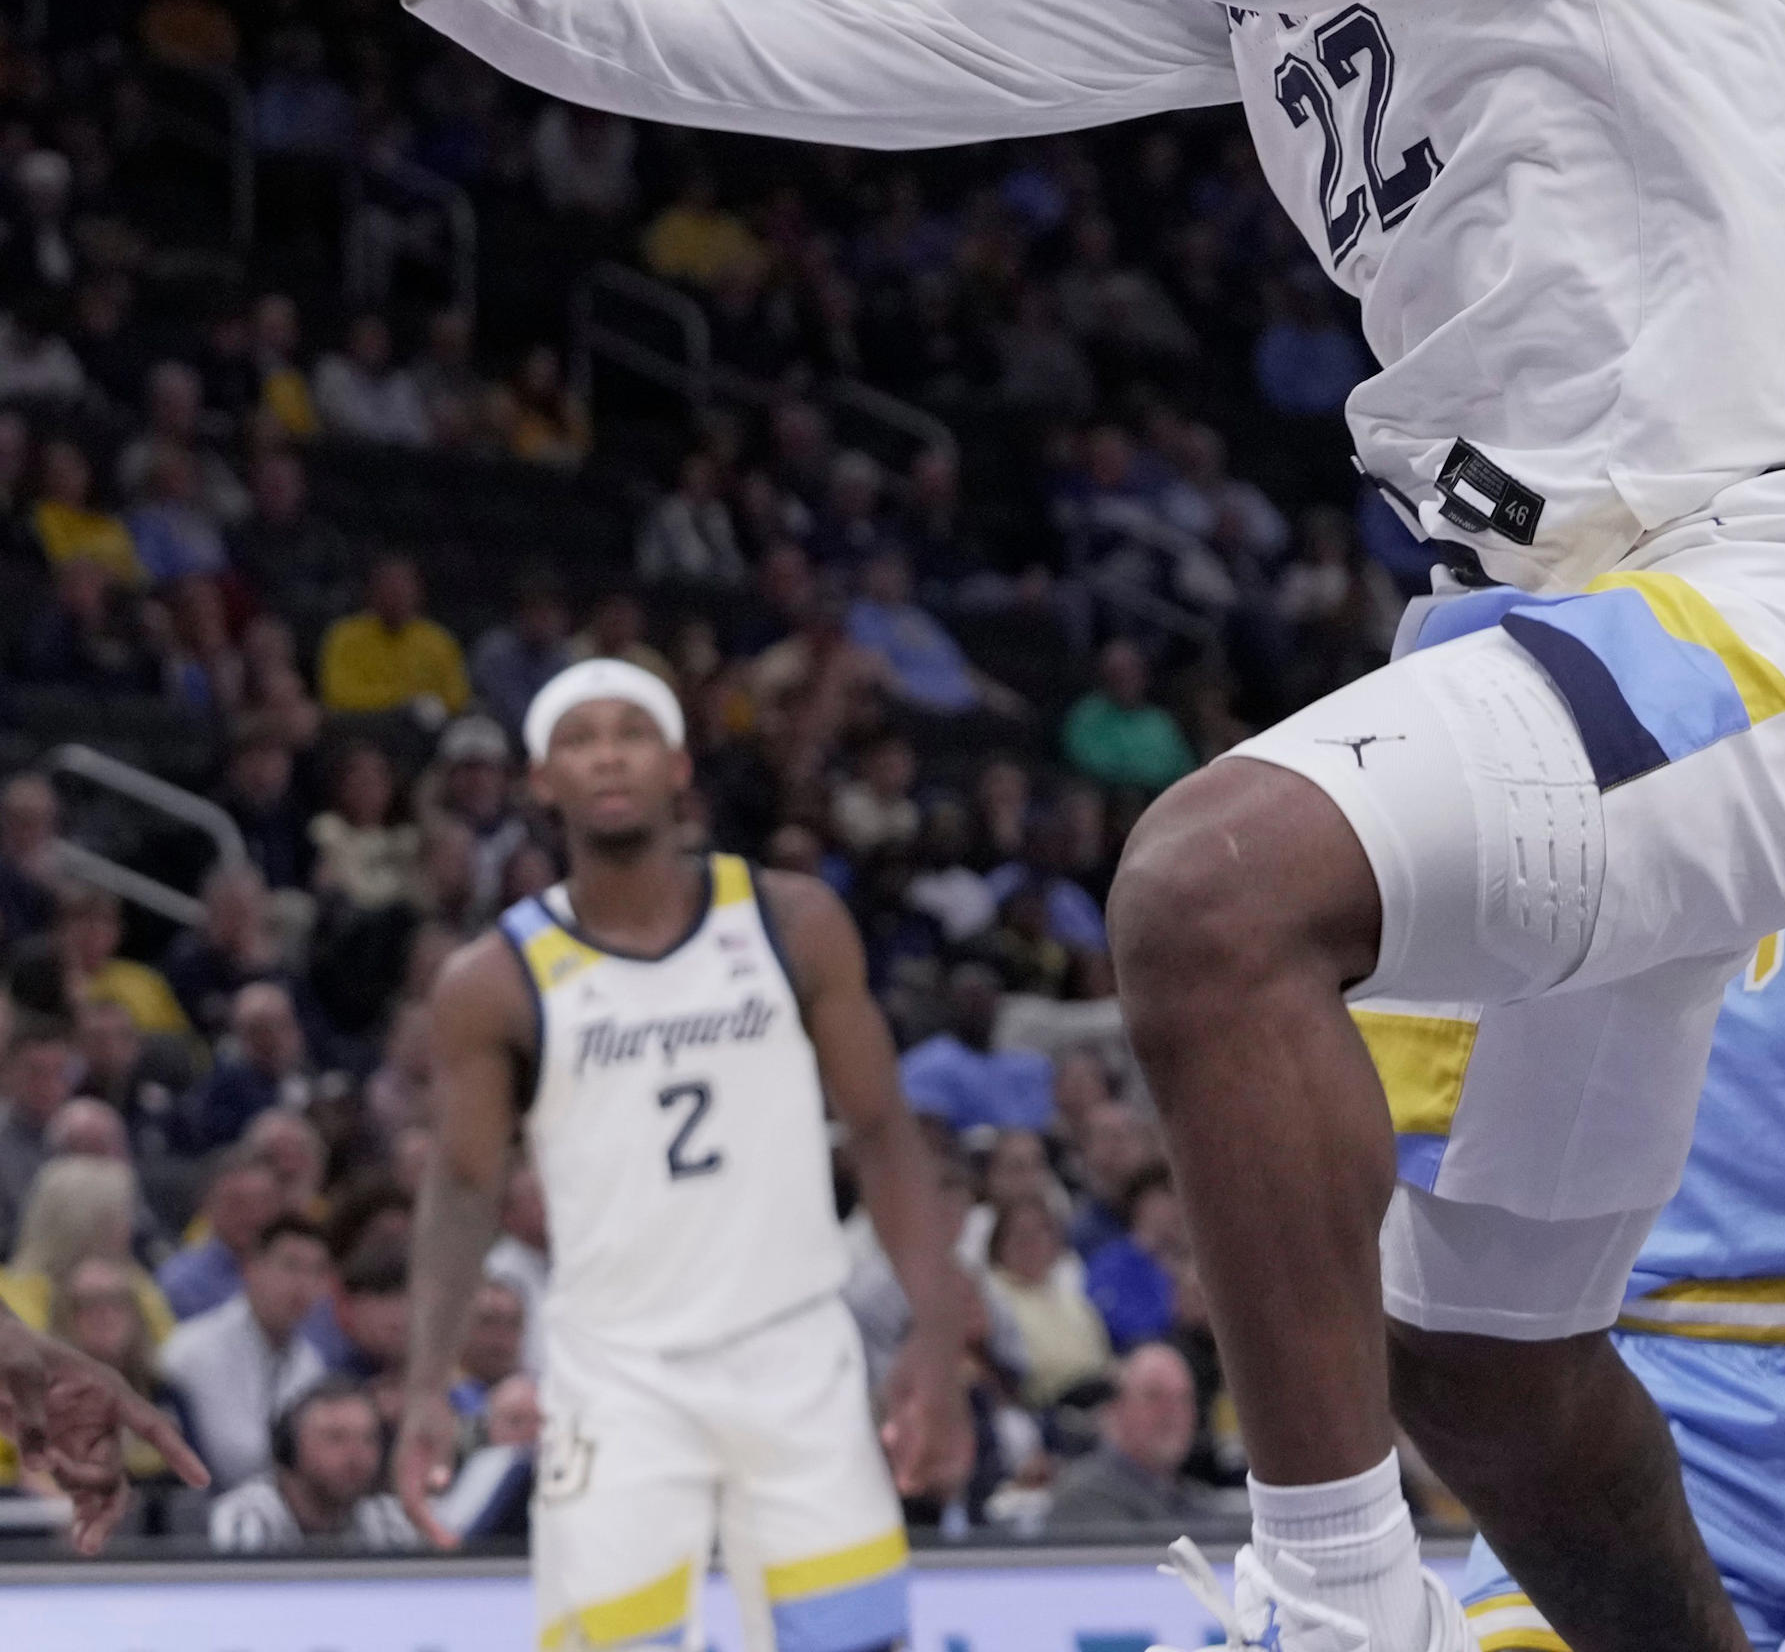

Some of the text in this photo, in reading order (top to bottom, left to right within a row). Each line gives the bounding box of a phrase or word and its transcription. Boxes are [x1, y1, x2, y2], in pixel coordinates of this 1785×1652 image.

[1274, 2, 1446, 272] 22
[1505, 500, 1530, 526] 46
[574, 995, 777, 1078] Marquette
[656, 1081, 725, 1181] 2
